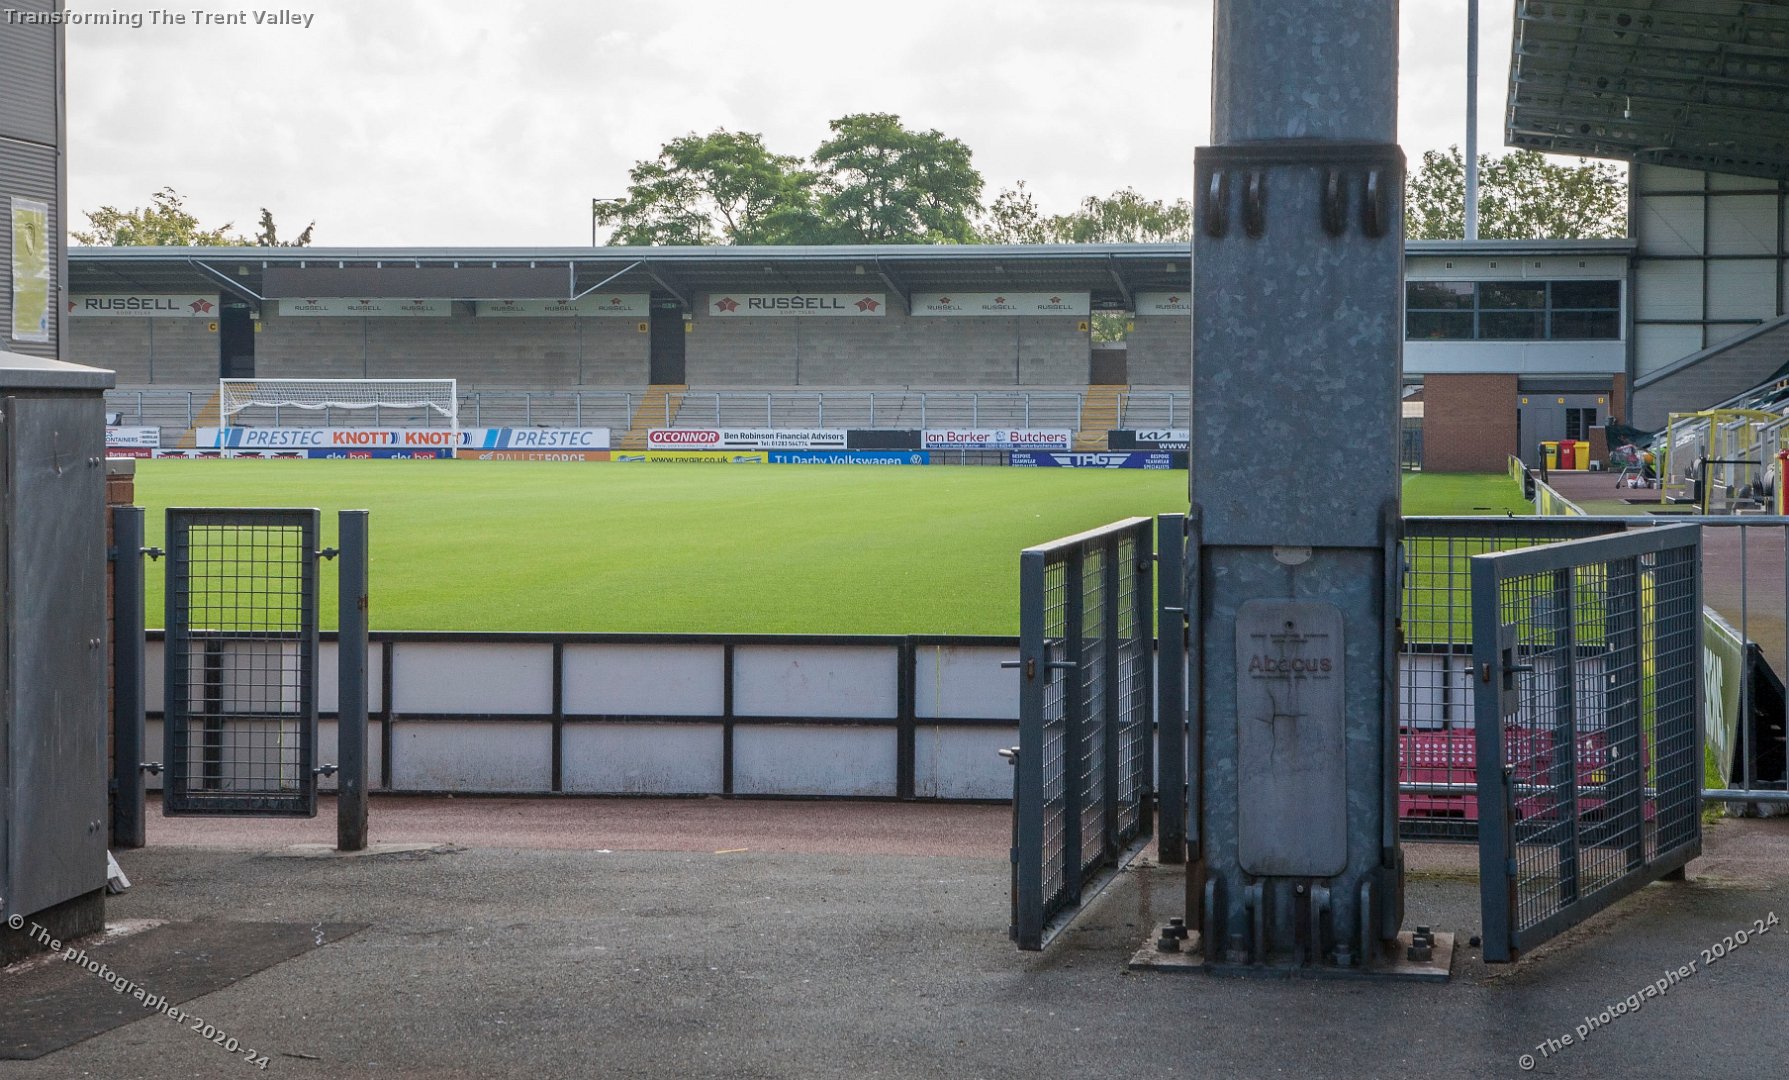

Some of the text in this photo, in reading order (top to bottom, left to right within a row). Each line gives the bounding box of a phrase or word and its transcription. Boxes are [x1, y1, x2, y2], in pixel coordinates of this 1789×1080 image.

[85, 297, 180, 310] RUSSELL
[748, 296, 845, 310] RUSSELL
[210, 323, 216, 331] C
[1079, 322, 1087, 331] A
[246, 430, 324, 445] PRESTEC
[333, 431, 389, 445] KNOTT
[515, 431, 593, 446] PRESTEC
[653, 432, 716, 442] O'CONNOR
[724, 432, 738, 440] Ben
[740, 432, 774, 440] Robinson
[811, 433, 844, 441] Advisors
[925, 431, 1067, 442] Ian Barker Butchers
[792, 455, 827, 464] Darby
[829, 455, 902, 465] Volkswagen
[1074, 453, 1109, 466] TAG
[1248, 655, 1332, 672] Abacus
